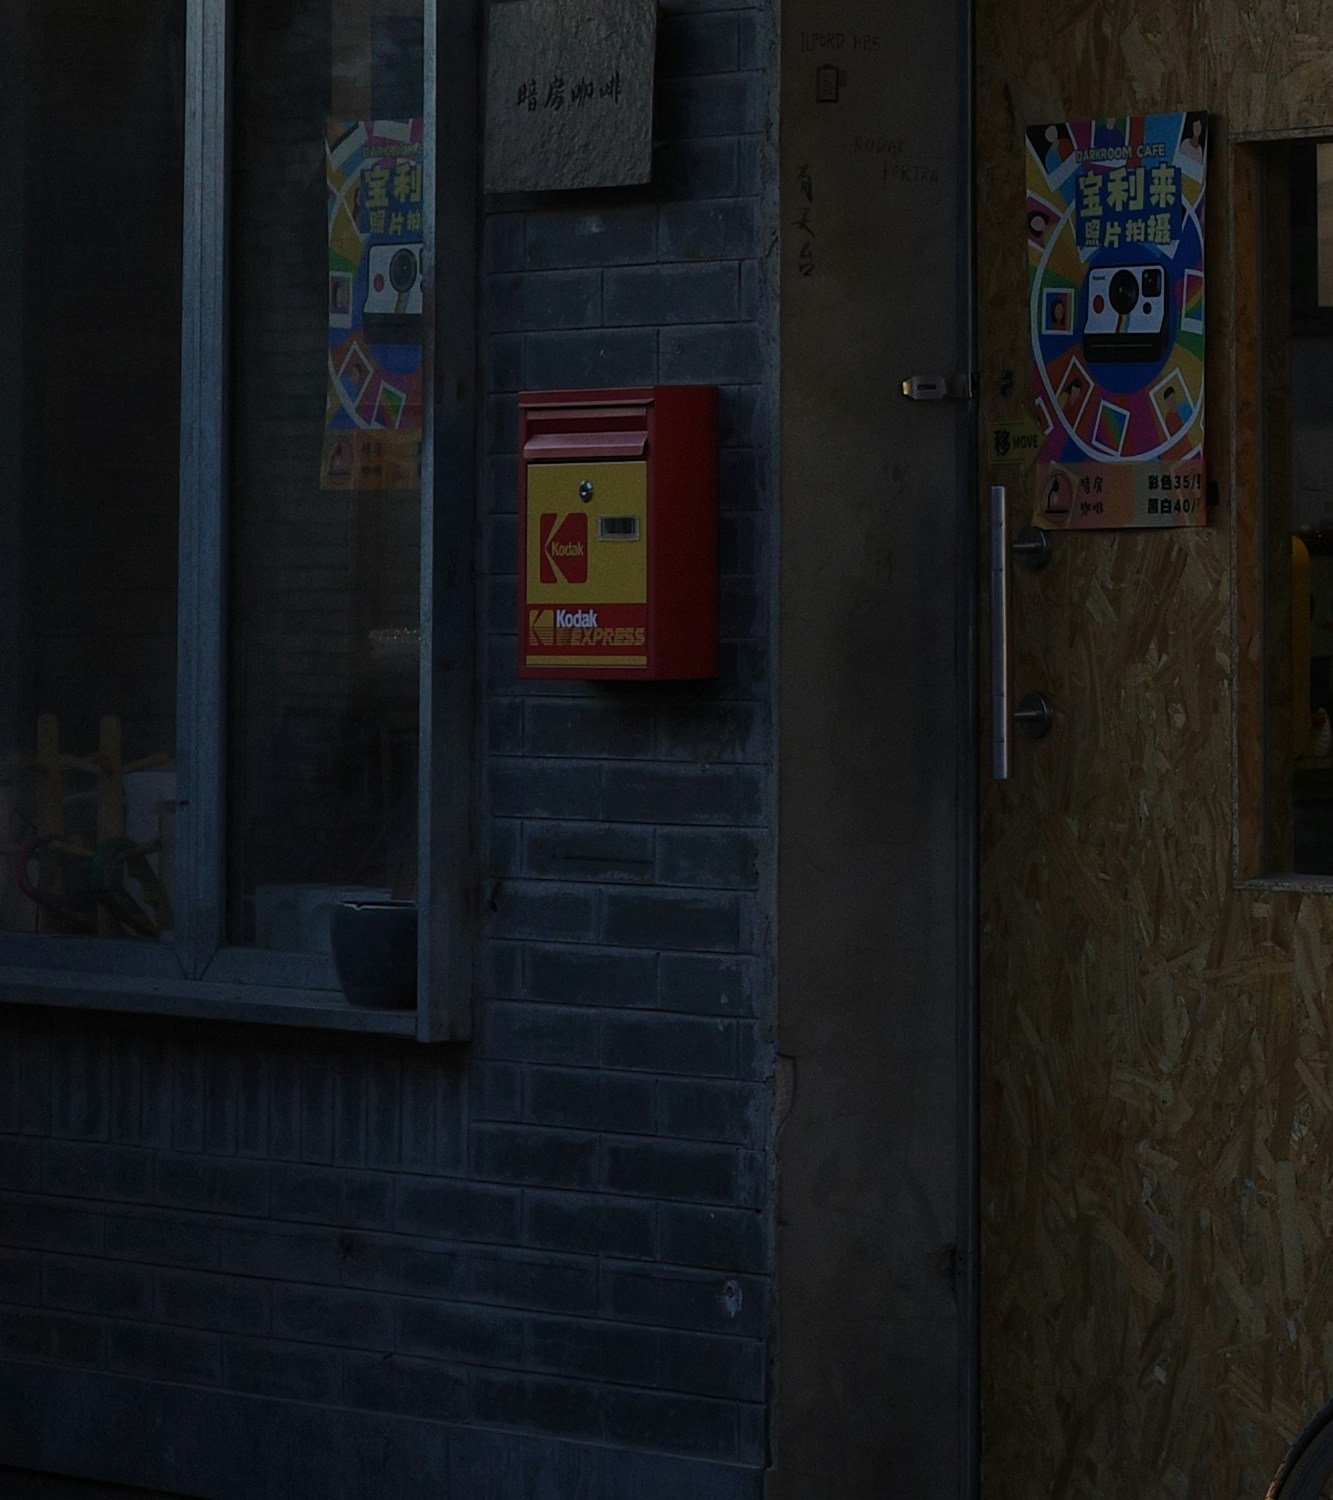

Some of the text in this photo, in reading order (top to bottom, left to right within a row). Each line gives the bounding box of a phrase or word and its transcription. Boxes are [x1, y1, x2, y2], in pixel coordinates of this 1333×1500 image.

[853, 33, 881, 52] HP5
[516, 70, 623, 112] 暗房咖啡
[1076, 144, 1165, 161] DARKROOM CAFE
[1079, 164, 1176, 216] 宝利来
[1085, 213, 1171, 248] 照片拍摄
[1012, 434, 1039, 449] MOVE
[551, 540, 584, 558] Kodak
[555, 608, 598, 628] Kodak
[570, 626, 646, 646] EXPRESS
